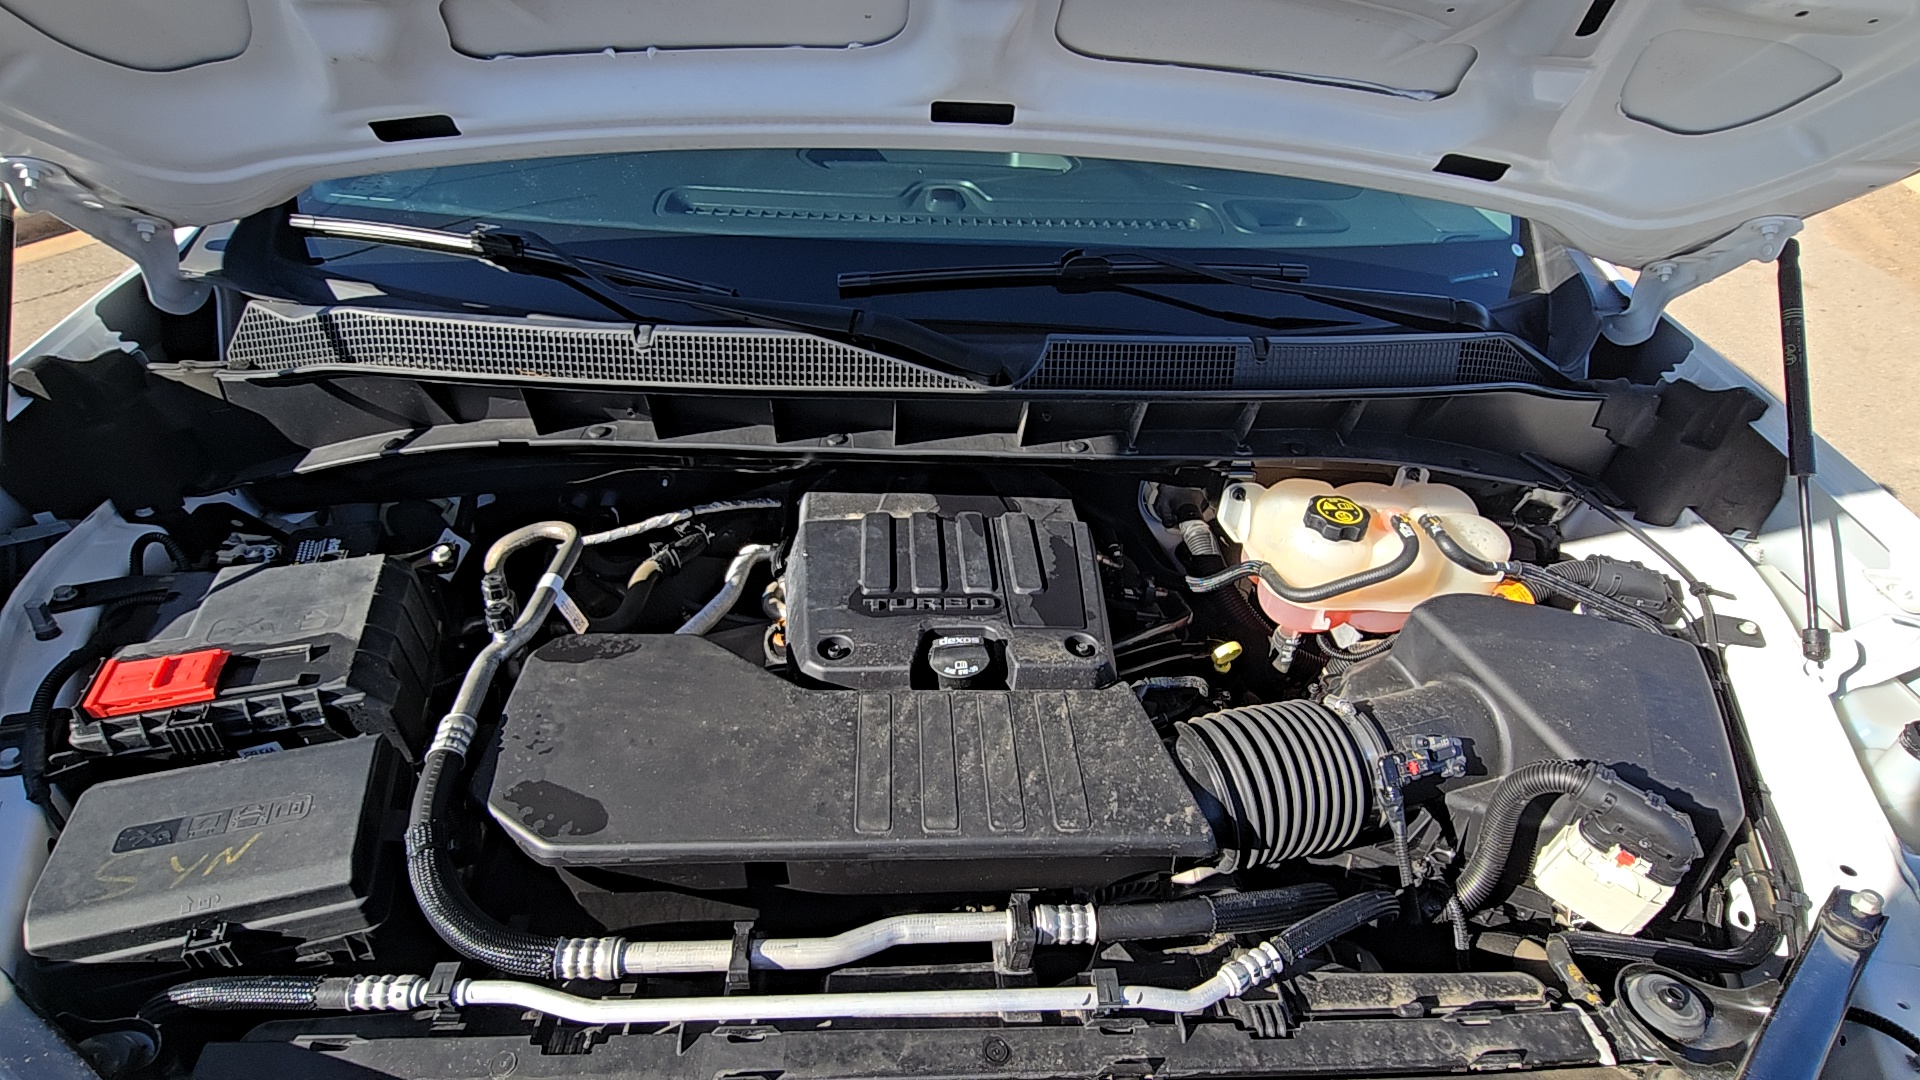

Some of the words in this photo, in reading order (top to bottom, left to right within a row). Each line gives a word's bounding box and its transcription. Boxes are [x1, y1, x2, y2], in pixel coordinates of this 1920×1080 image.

[862, 597, 998, 612] TURBO
[938, 636, 980, 645] dexos
[88, 831, 263, 902] SYN
